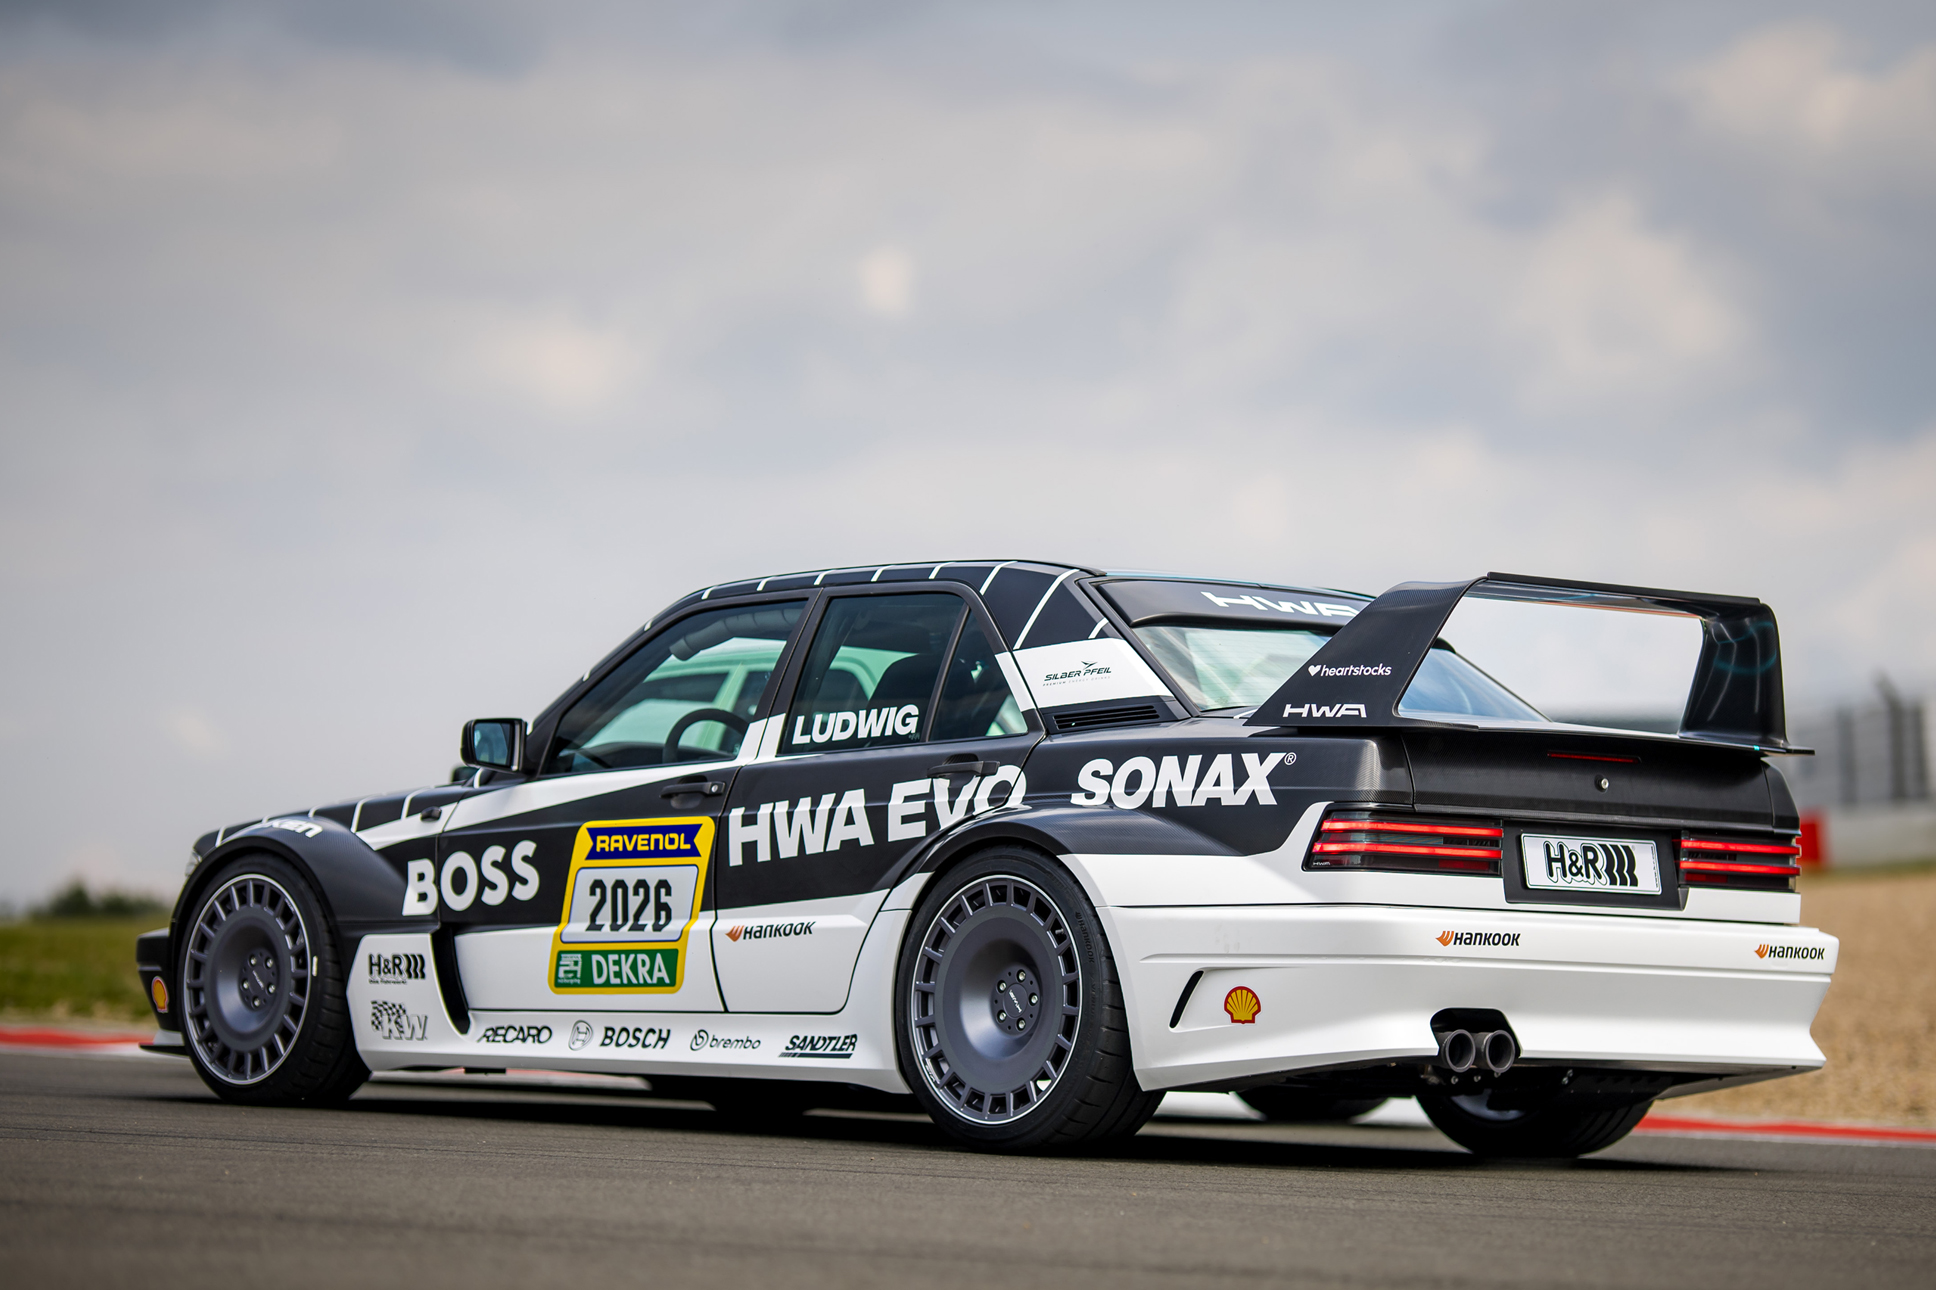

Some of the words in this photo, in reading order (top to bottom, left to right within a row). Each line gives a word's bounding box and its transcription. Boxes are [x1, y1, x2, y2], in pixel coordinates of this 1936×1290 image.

[1200, 591, 1360, 617] HWA
[1043, 670, 1081, 682] SILBER
[1082, 666, 1112, 677] PFEIL
[1320, 663, 1392, 678] heartstocks
[1282, 703, 1367, 718] HWA
[792, 704, 920, 745] LUDWIG
[728, 788, 875, 867] HWA
[887, 764, 1028, 843] EVO
[595, 832, 693, 853] RAVENOL
[1542, 840, 1607, 885] H&R
[402, 839, 541, 917] BOSS
[585, 878, 674, 932] 2026
[368, 953, 405, 980] H&R
[591, 951, 671, 986] DEKRA
[382, 1013, 428, 1041] KW
[477, 1023, 553, 1045] RECARO
[600, 1026, 671, 1050] BOSCH
[709, 1032, 761, 1050] brembo
[784, 1033, 858, 1052] SANDTLER
